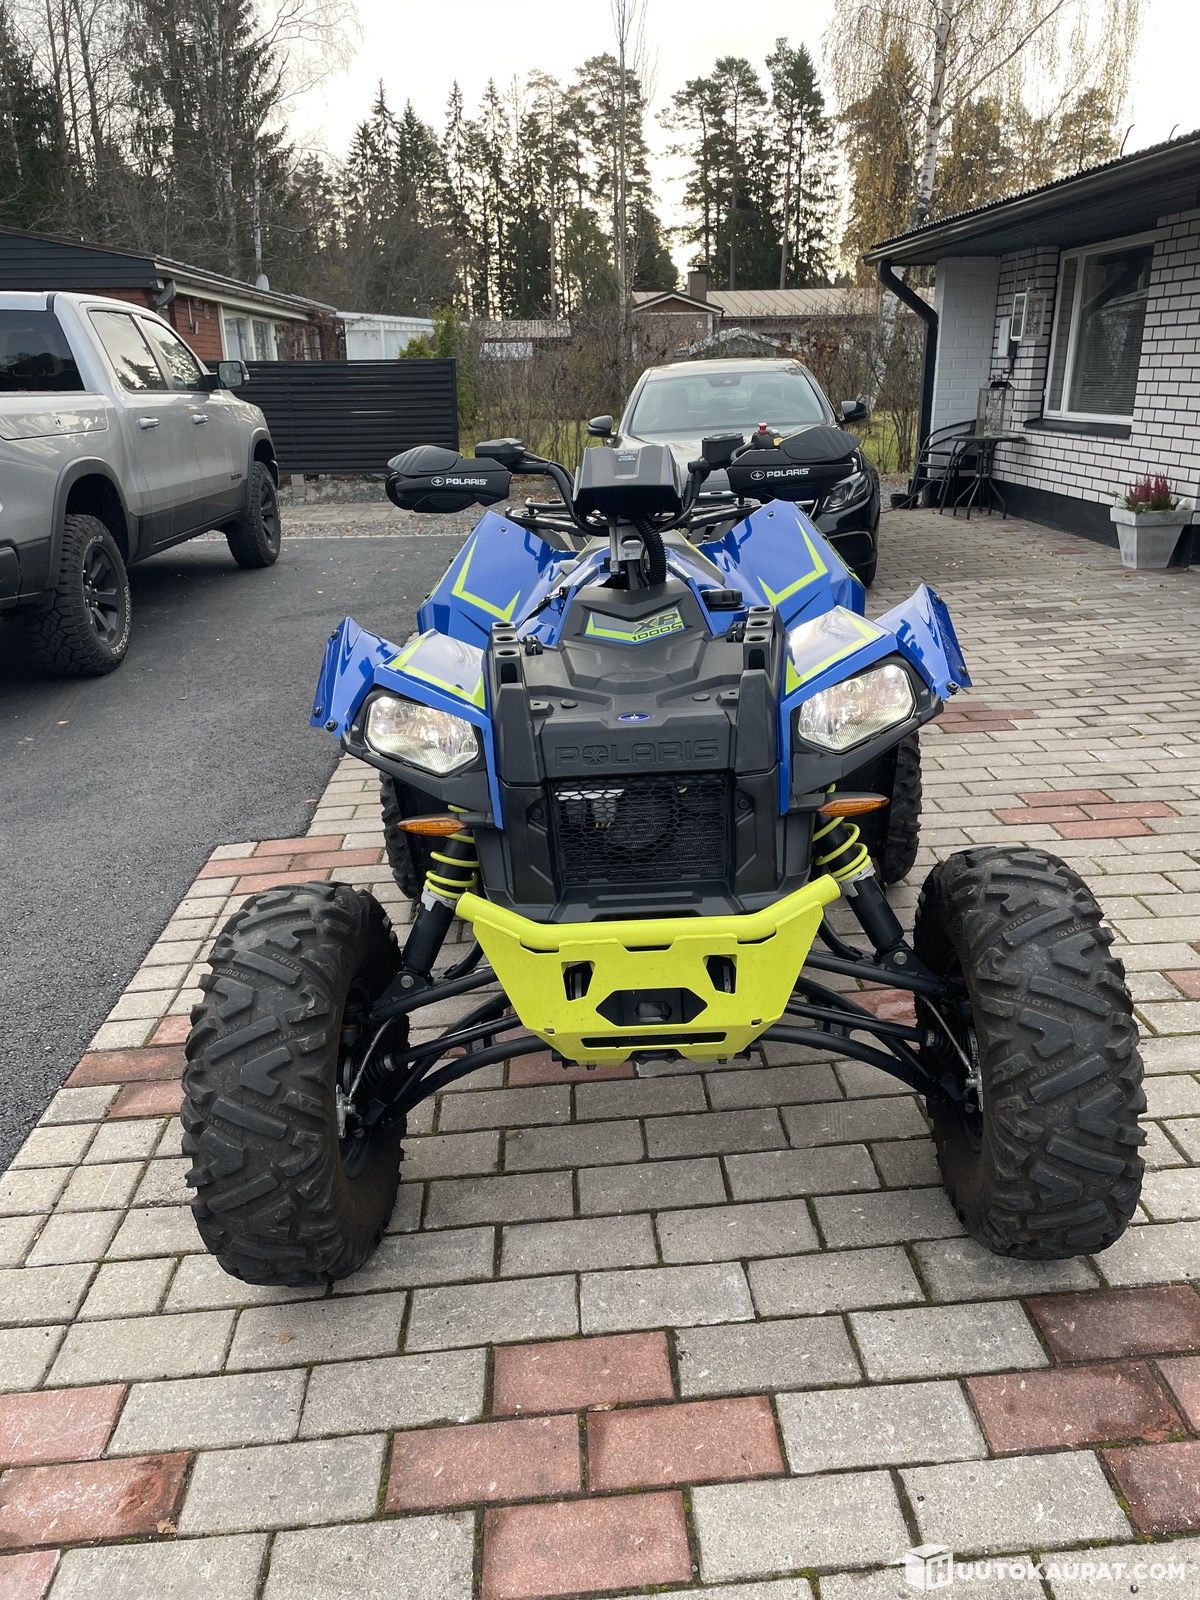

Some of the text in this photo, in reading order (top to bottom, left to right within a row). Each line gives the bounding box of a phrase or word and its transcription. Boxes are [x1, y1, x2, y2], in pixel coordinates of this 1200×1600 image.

[445, 478, 488, 486] POLARIS
[766, 468, 810, 478] POLARIS
[632, 621, 683, 641] 1000S
[633, 612, 679, 634] XP
[554, 739, 720, 768] POLARIS
